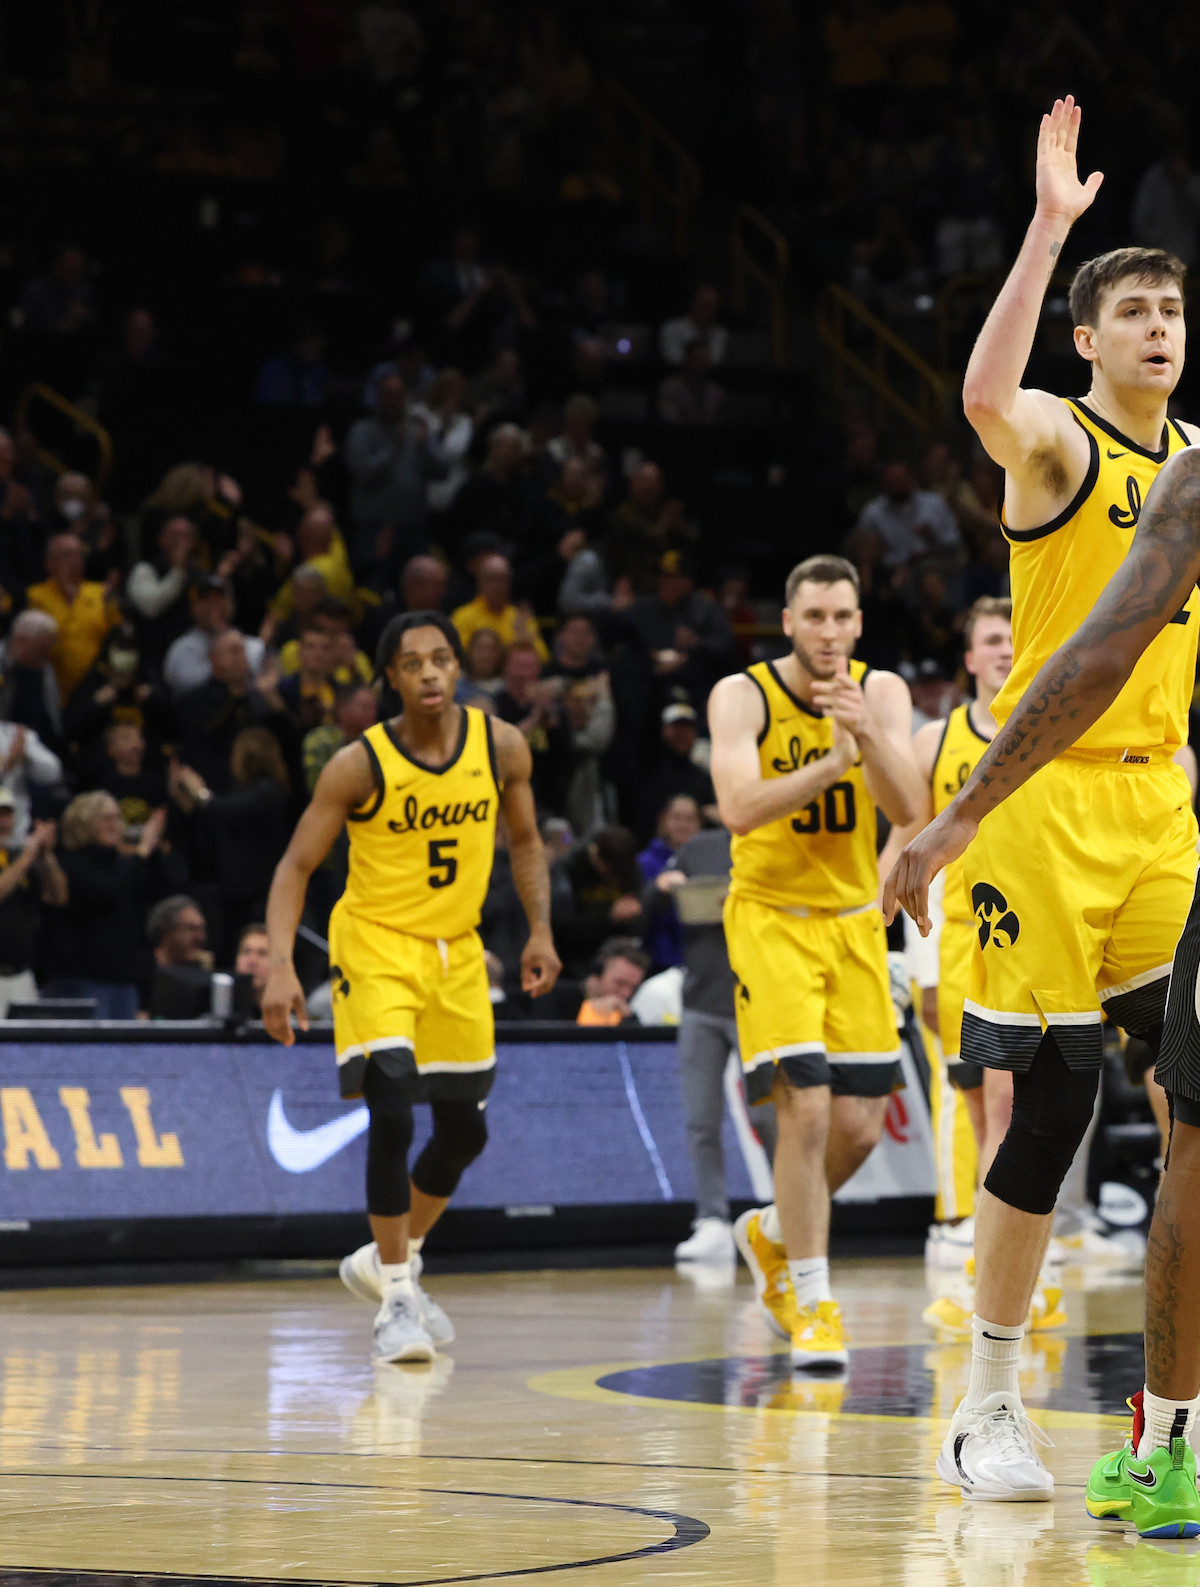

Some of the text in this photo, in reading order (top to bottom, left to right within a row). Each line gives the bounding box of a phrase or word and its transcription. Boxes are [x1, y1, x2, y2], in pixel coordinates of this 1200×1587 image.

[388, 795, 490, 833] Iowa
[428, 839, 458, 889] 5
[0, 1086, 185, 1170] ALL
